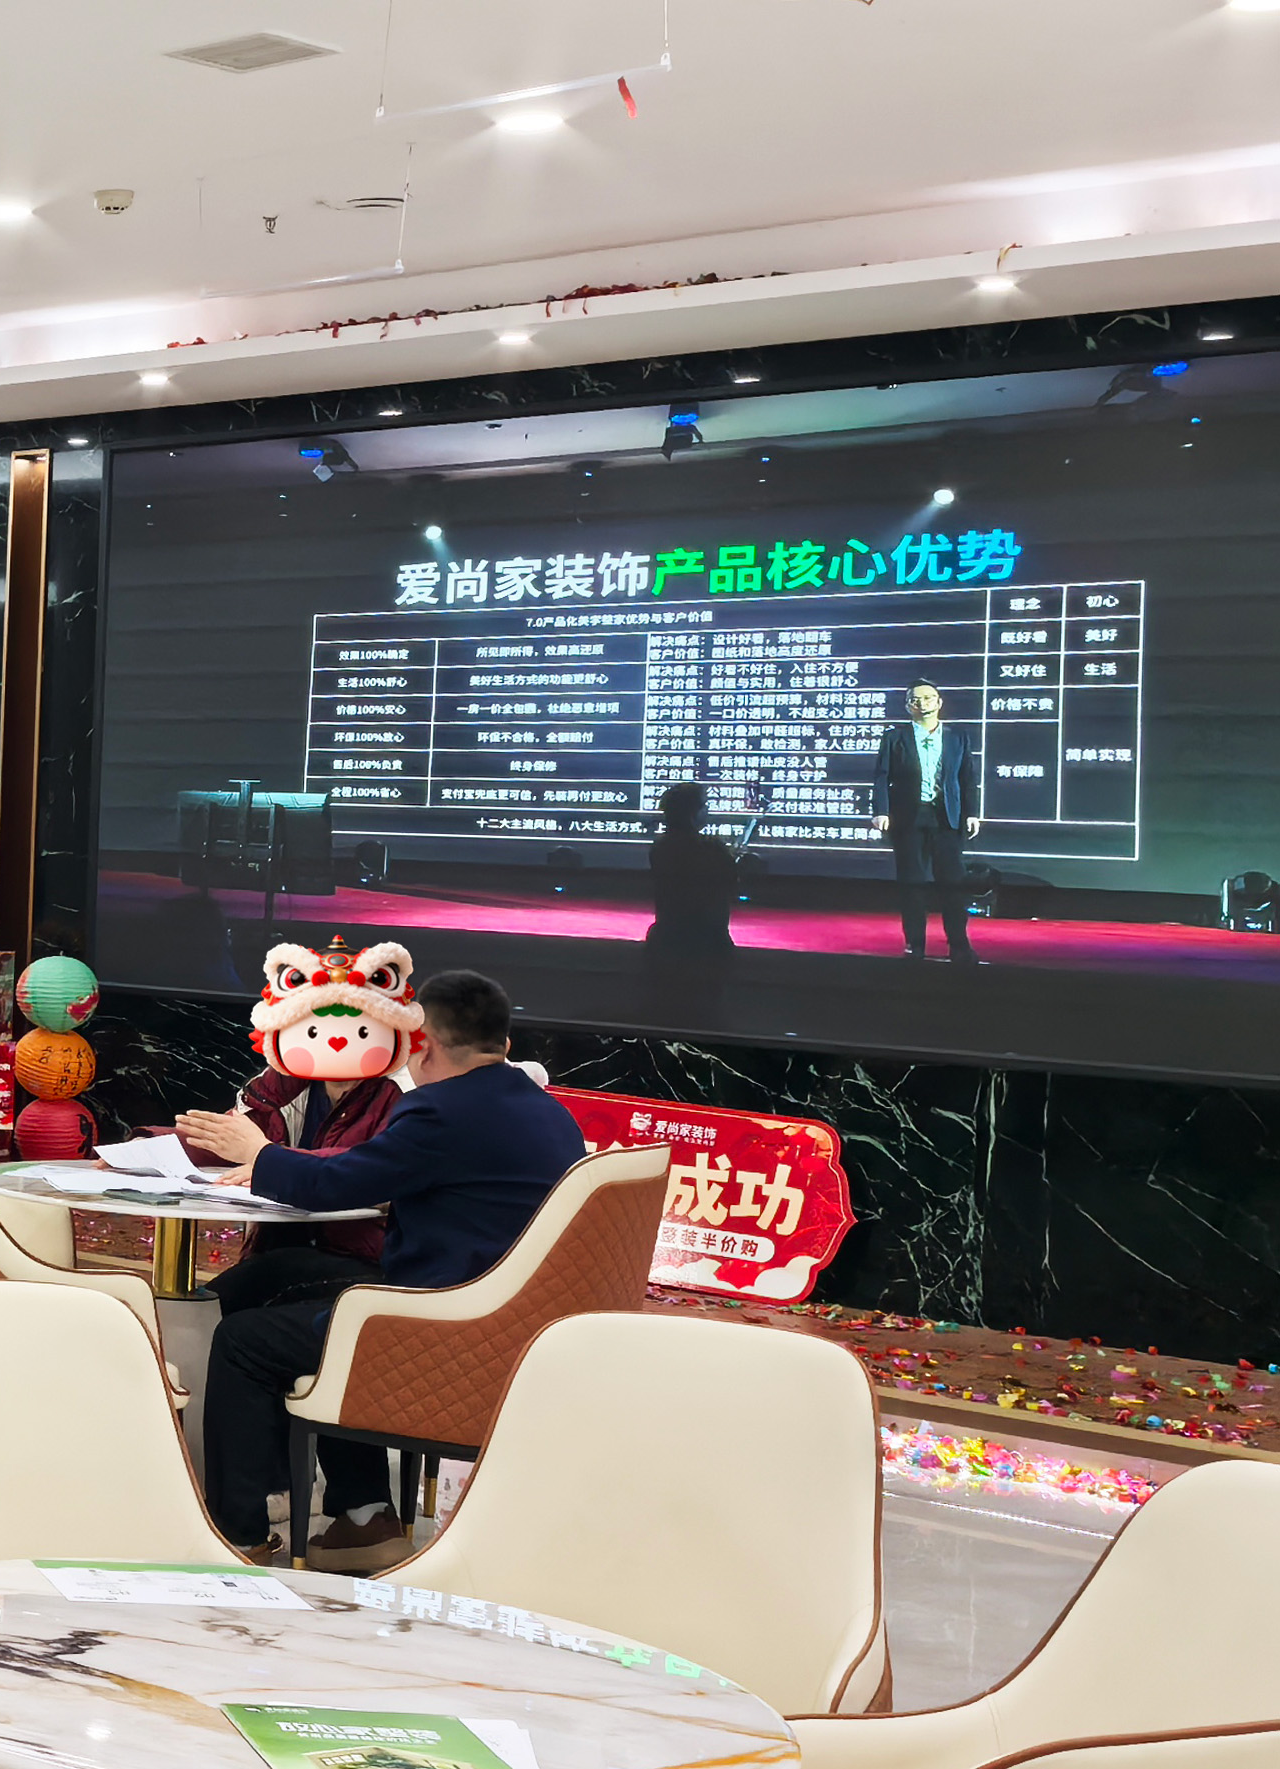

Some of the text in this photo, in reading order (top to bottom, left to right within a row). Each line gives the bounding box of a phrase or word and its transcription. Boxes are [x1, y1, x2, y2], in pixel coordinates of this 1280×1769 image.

[394, 528, 1022, 606] 爱尚家装饰产品核心优势
[1009, 597, 1041, 611] 理念
[1086, 595, 1119, 608] 初心
[1000, 630, 1048, 645] 既好看
[1084, 628, 1118, 642] 美好
[338, 649, 410, 661] 效果100%确定
[999, 664, 1048, 678] 又好住
[1083, 662, 1118, 677] 生活
[337, 676, 408, 688] 生活100%舒心
[335, 703, 407, 716] 价格100%安心
[334, 731, 405, 743] 环保100%放心
[644, 723, 895, 738] 解决痛点：材料叠加甲醛超标，住的不安
[1065, 748, 1133, 762] 简单实现
[996, 764, 1044, 778] 有保障
[654, 1120, 717, 1140] 爱尚家装饰
[664, 1152, 805, 1237] 成功
[660, 1226, 759, 1258] 整装半价购
